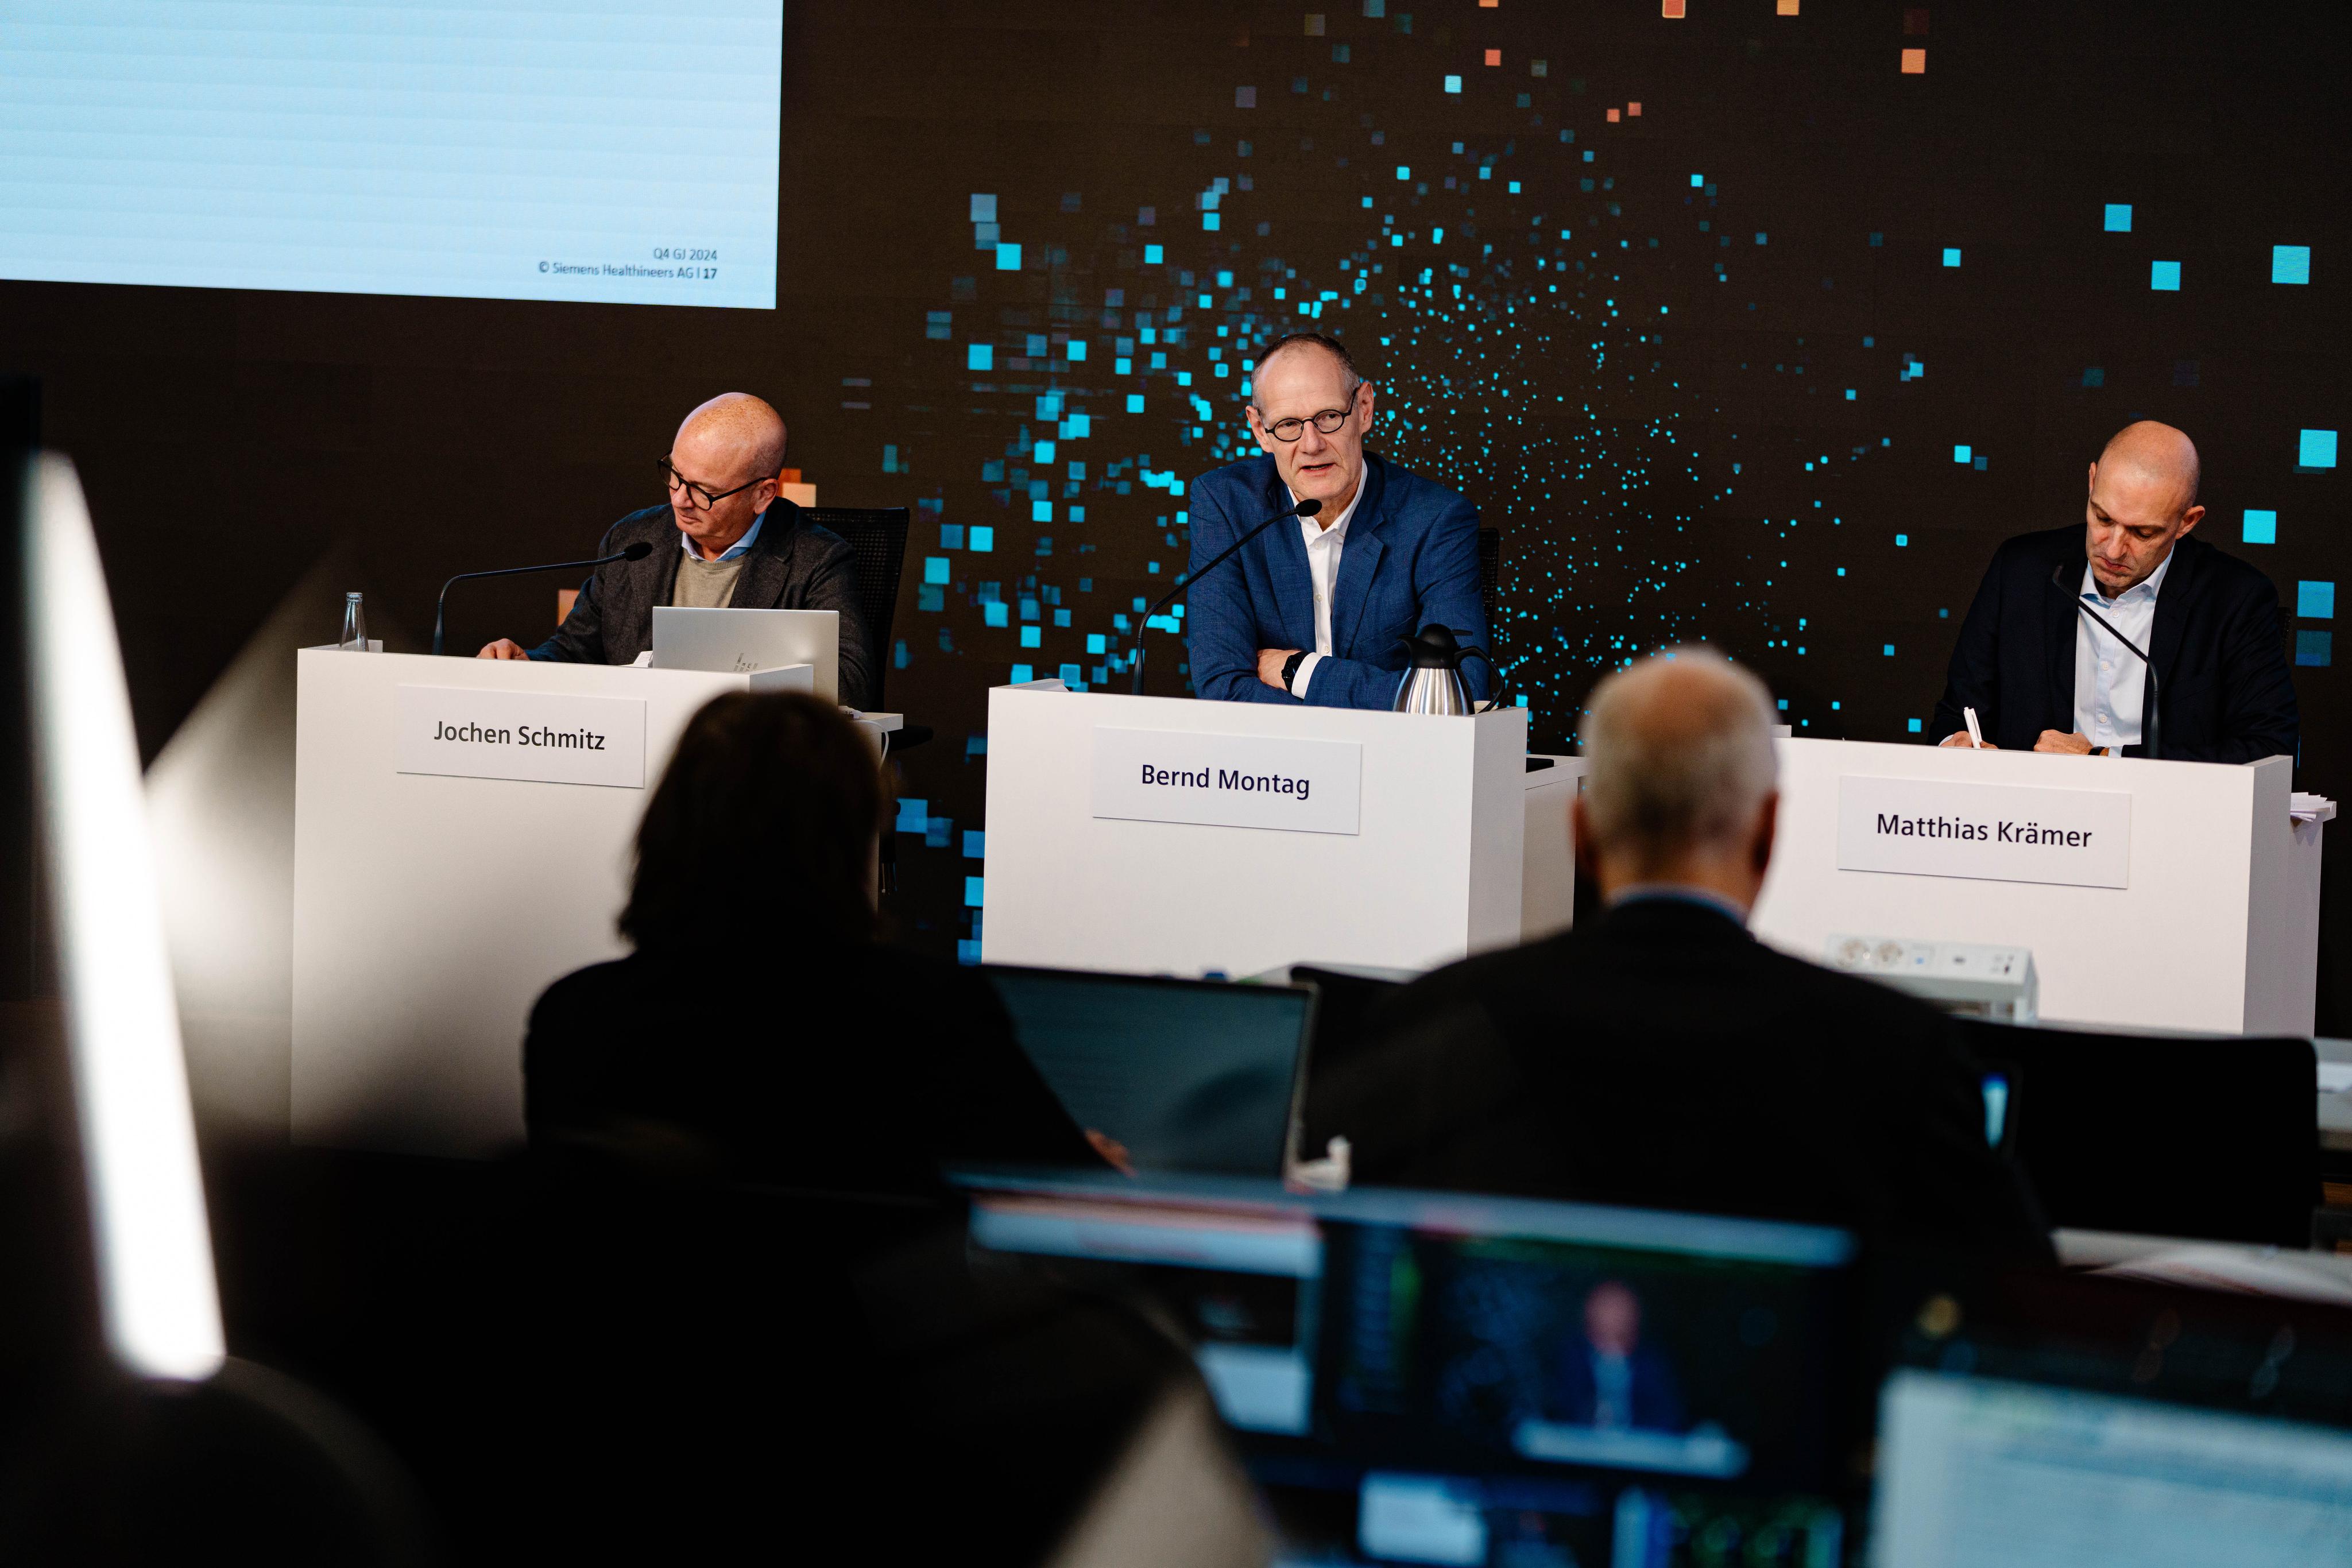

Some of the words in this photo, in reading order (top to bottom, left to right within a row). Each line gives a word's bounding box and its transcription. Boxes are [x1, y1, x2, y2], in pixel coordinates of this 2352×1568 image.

[653, 247, 670, 260] Q4
[689, 249, 717, 261] 2024
[552, 262, 599, 276] Siemens
[603, 264, 674, 278] Healthineers
[677, 267, 694, 278] AG
[703, 268, 717, 279] 17
[434, 721, 510, 744] Jochen
[519, 726, 605, 750] Schmitz
[1142, 764, 1210, 788] Bernd
[1218, 769, 1310, 800] Montag
[1877, 813, 1988, 841] Matthias
[1997, 821, 2092, 847] Krämer
